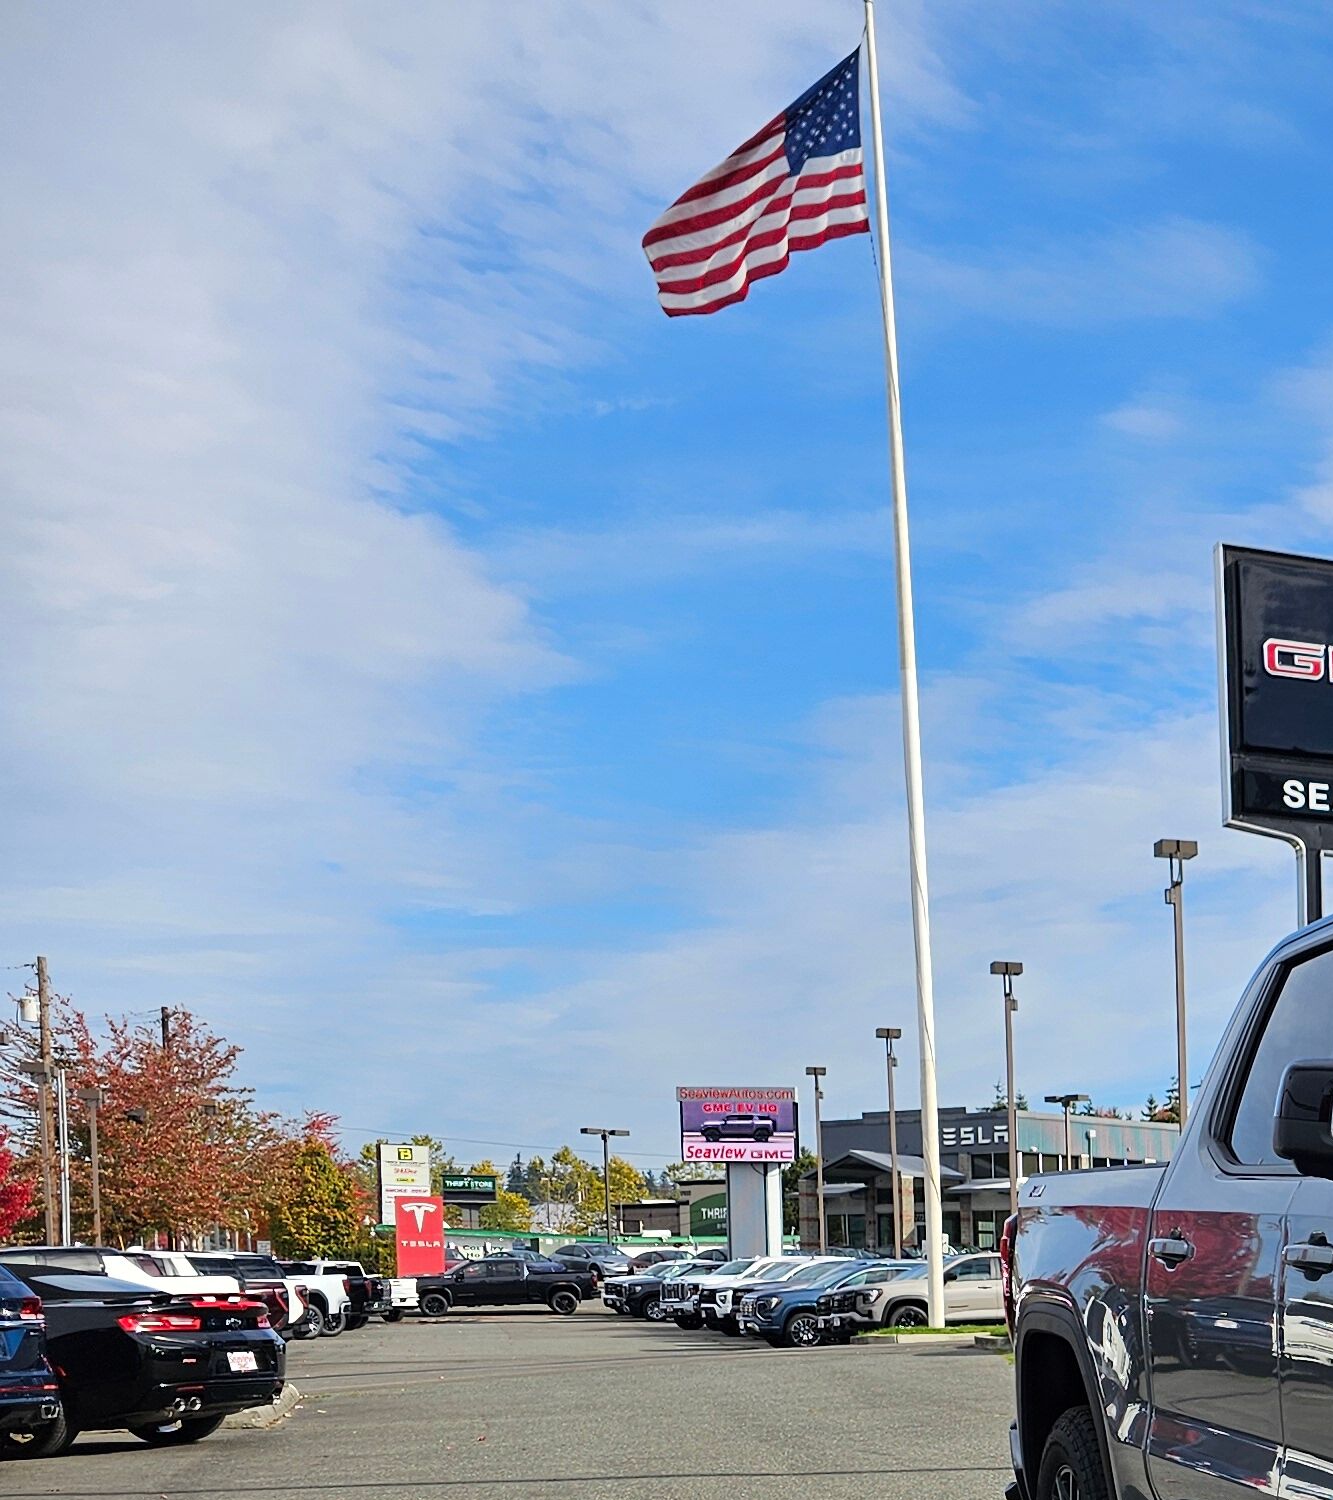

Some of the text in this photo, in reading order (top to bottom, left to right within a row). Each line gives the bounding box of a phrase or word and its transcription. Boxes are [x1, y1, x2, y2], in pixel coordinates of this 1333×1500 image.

[680, 1088, 793, 1099] SeaviewAutos.com
[703, 1103, 777, 1113] GMC EV HQ
[686, 1146, 793, 1159] Seaview GMC
[401, 1240, 441, 1248] TESLA
